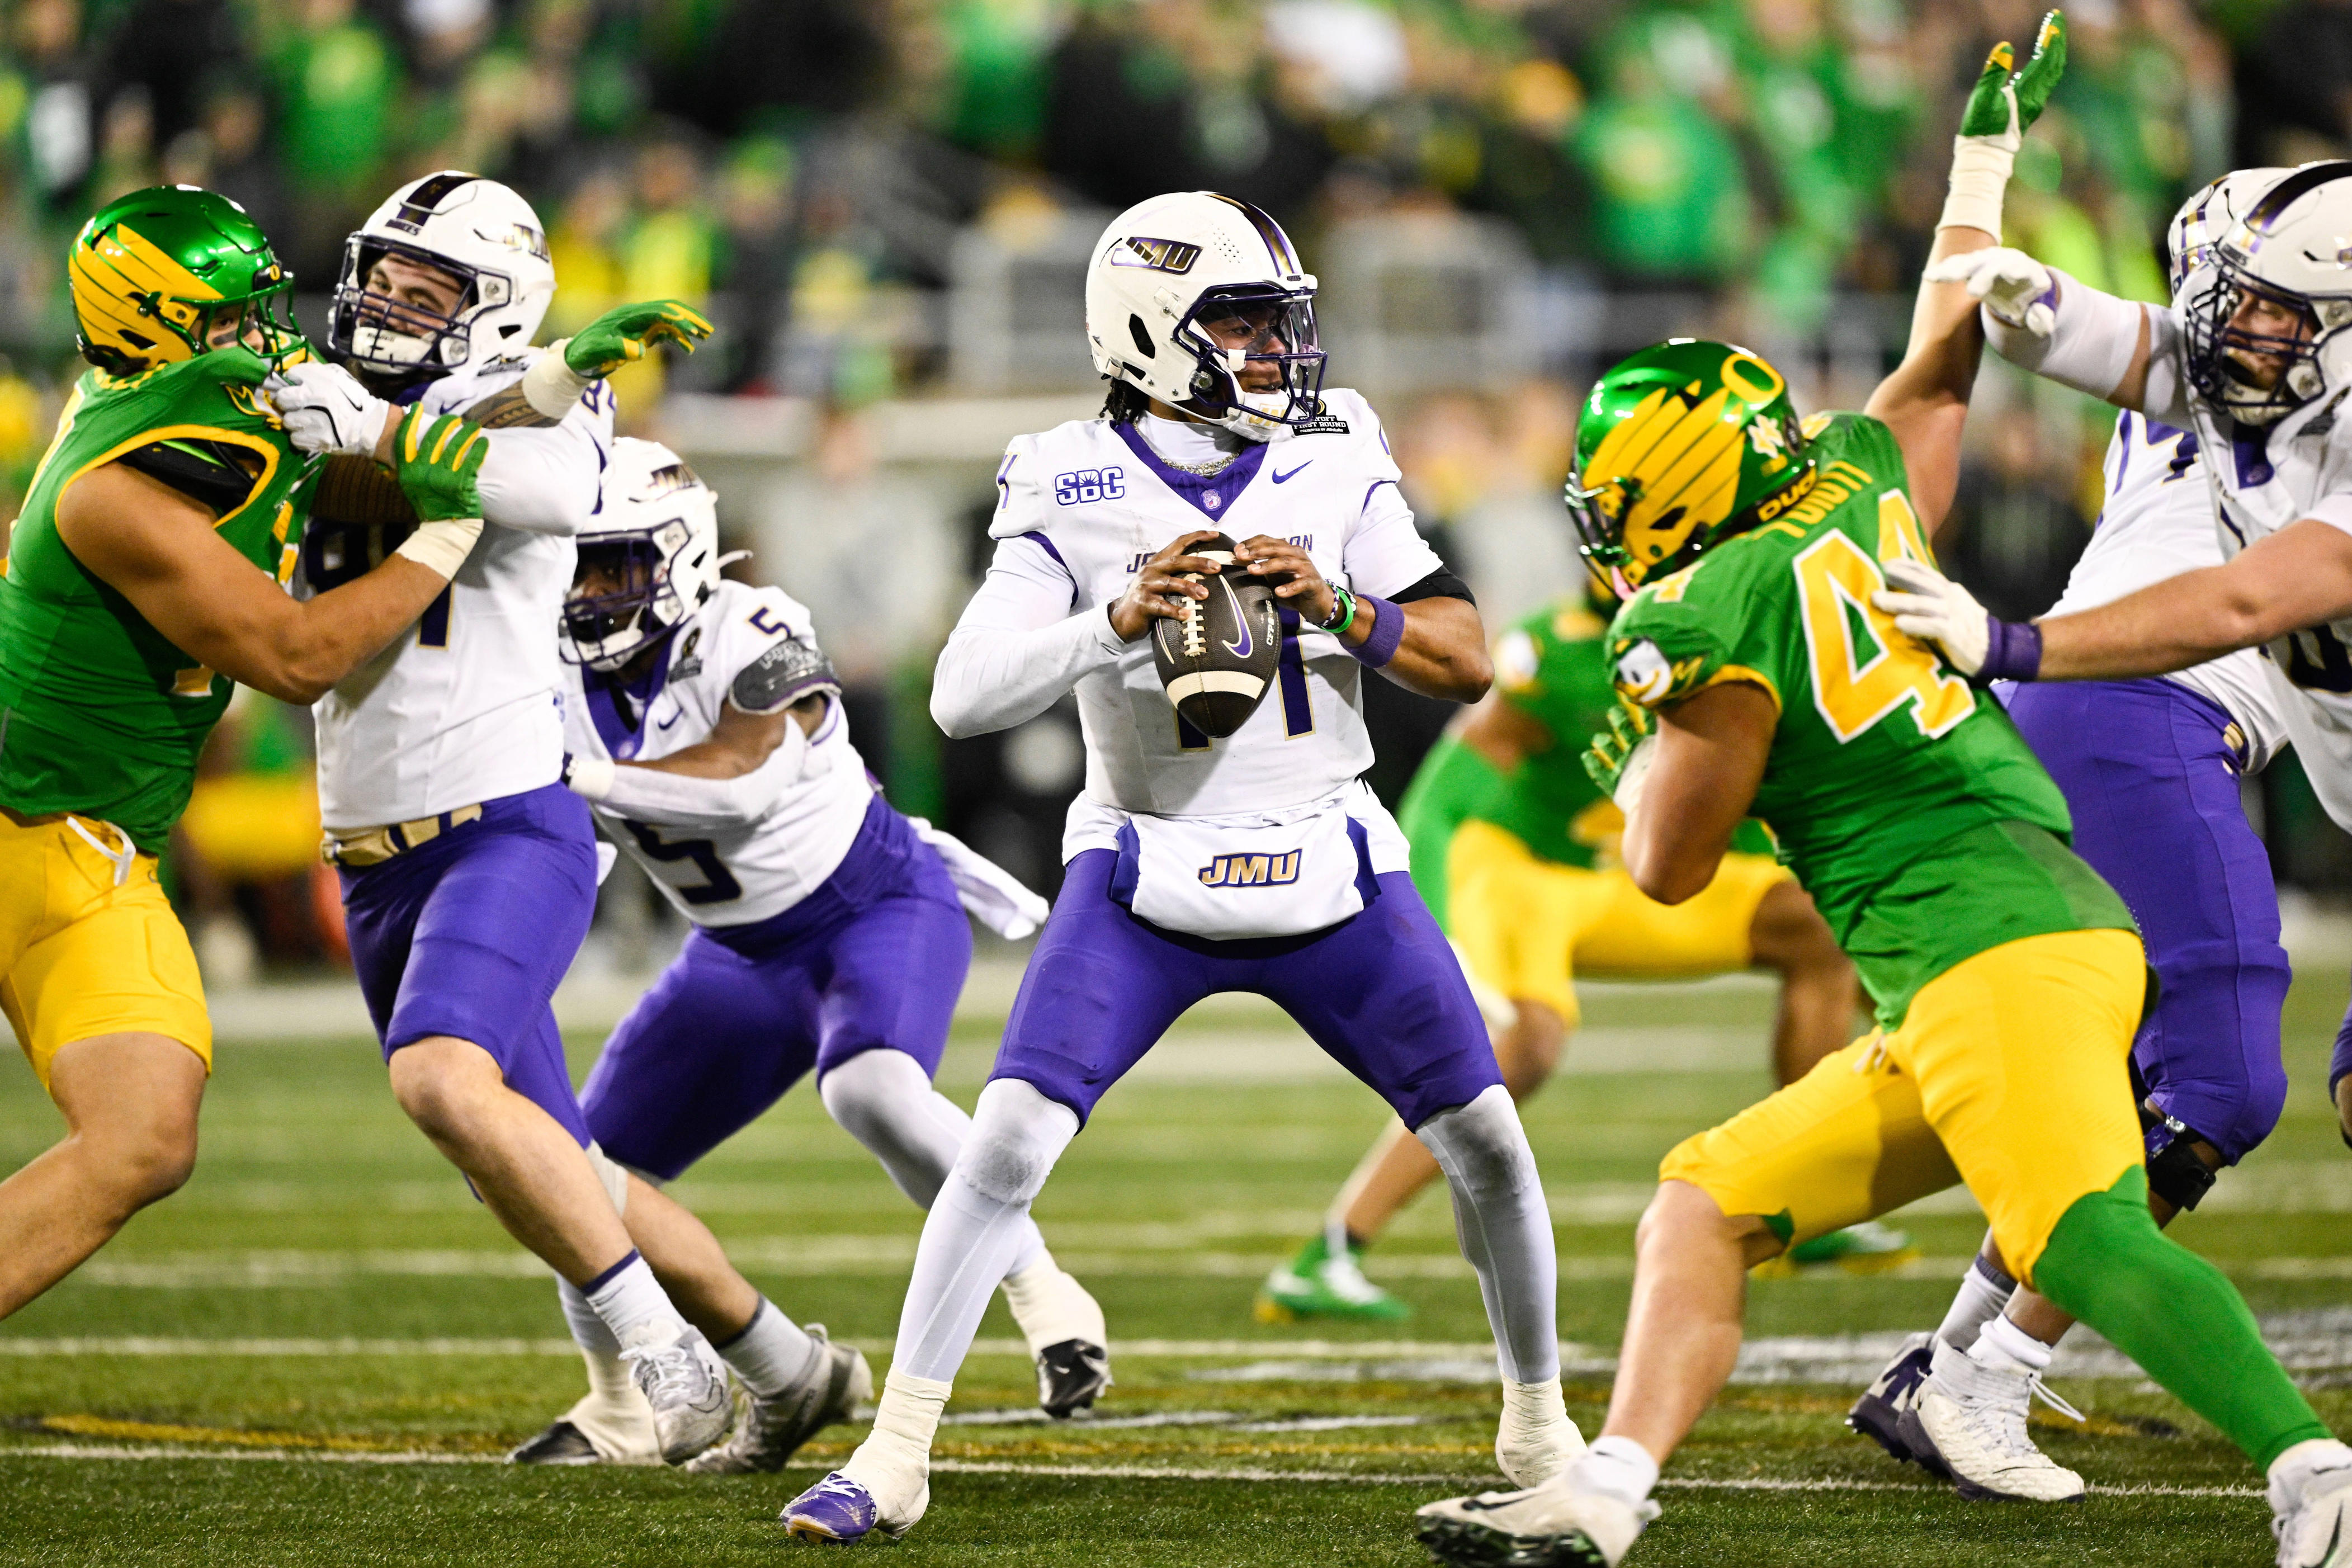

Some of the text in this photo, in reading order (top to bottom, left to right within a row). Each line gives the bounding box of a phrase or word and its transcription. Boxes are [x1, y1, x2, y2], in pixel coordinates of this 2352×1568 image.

[1055, 466, 1125, 506] SBC
[747, 605, 792, 641] 5
[1199, 850, 1301, 887] JMU
